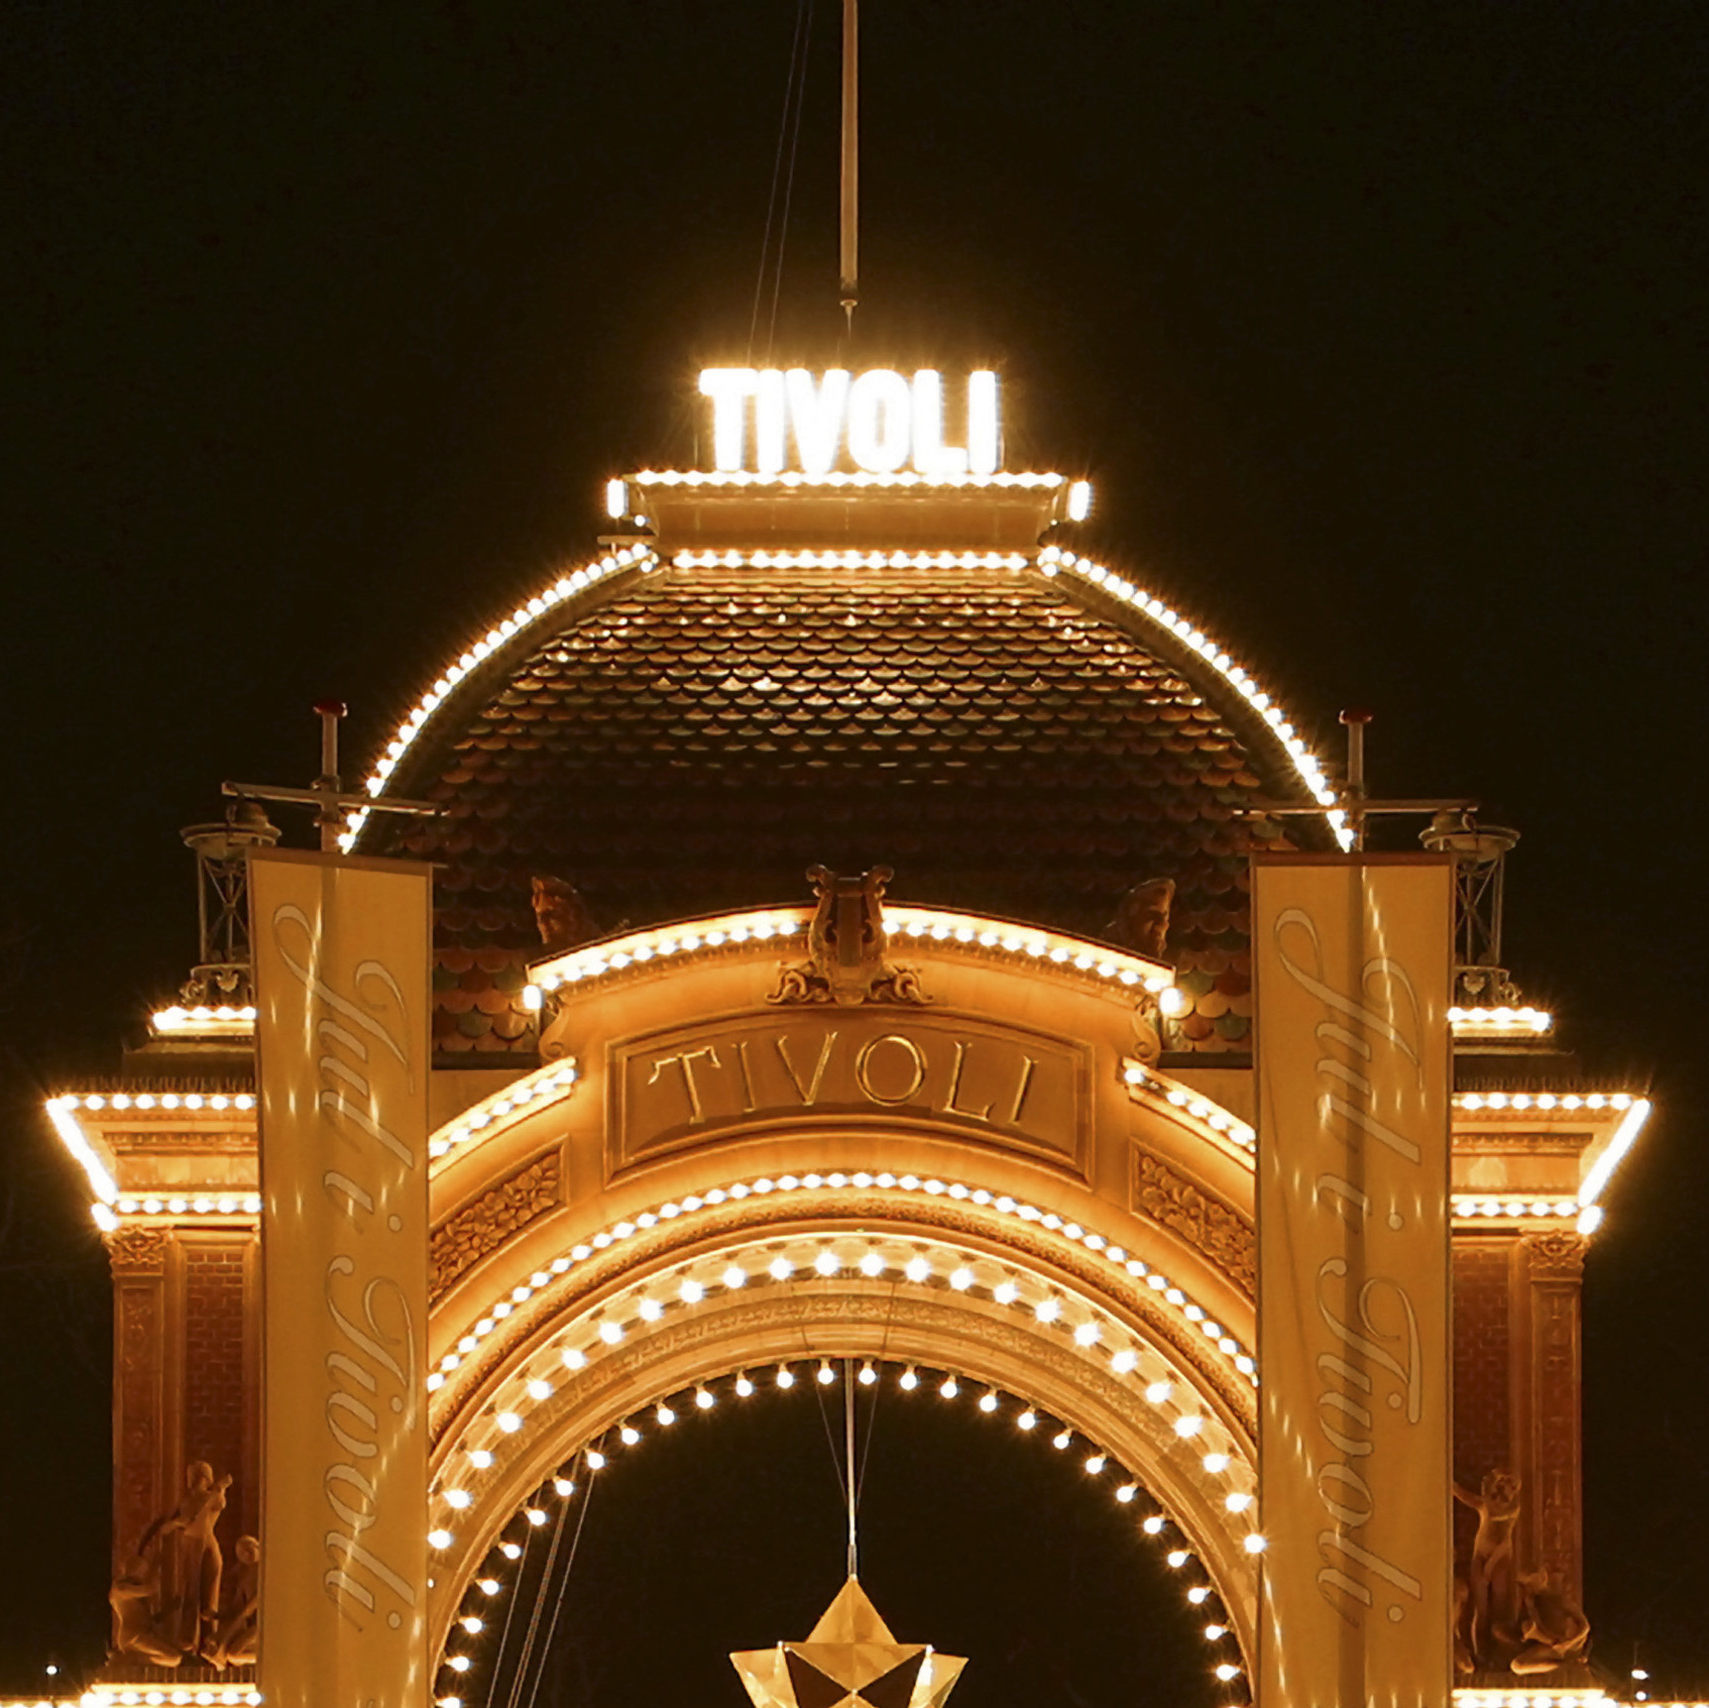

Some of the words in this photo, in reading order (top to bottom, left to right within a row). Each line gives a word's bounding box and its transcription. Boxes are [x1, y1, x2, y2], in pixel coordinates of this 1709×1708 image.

[698, 368, 1001, 474] TIVOLI
[272, 903, 415, 1170] Jul
[646, 1031, 1038, 1124] TIVOLI
[1274, 907, 1424, 1165] Jul
[323, 1169, 403, 1235] i
[1316, 1172, 1404, 1235] i
[324, 1254, 417, 1633] Tivoli
[1317, 1257, 1423, 1629] Tivoli
